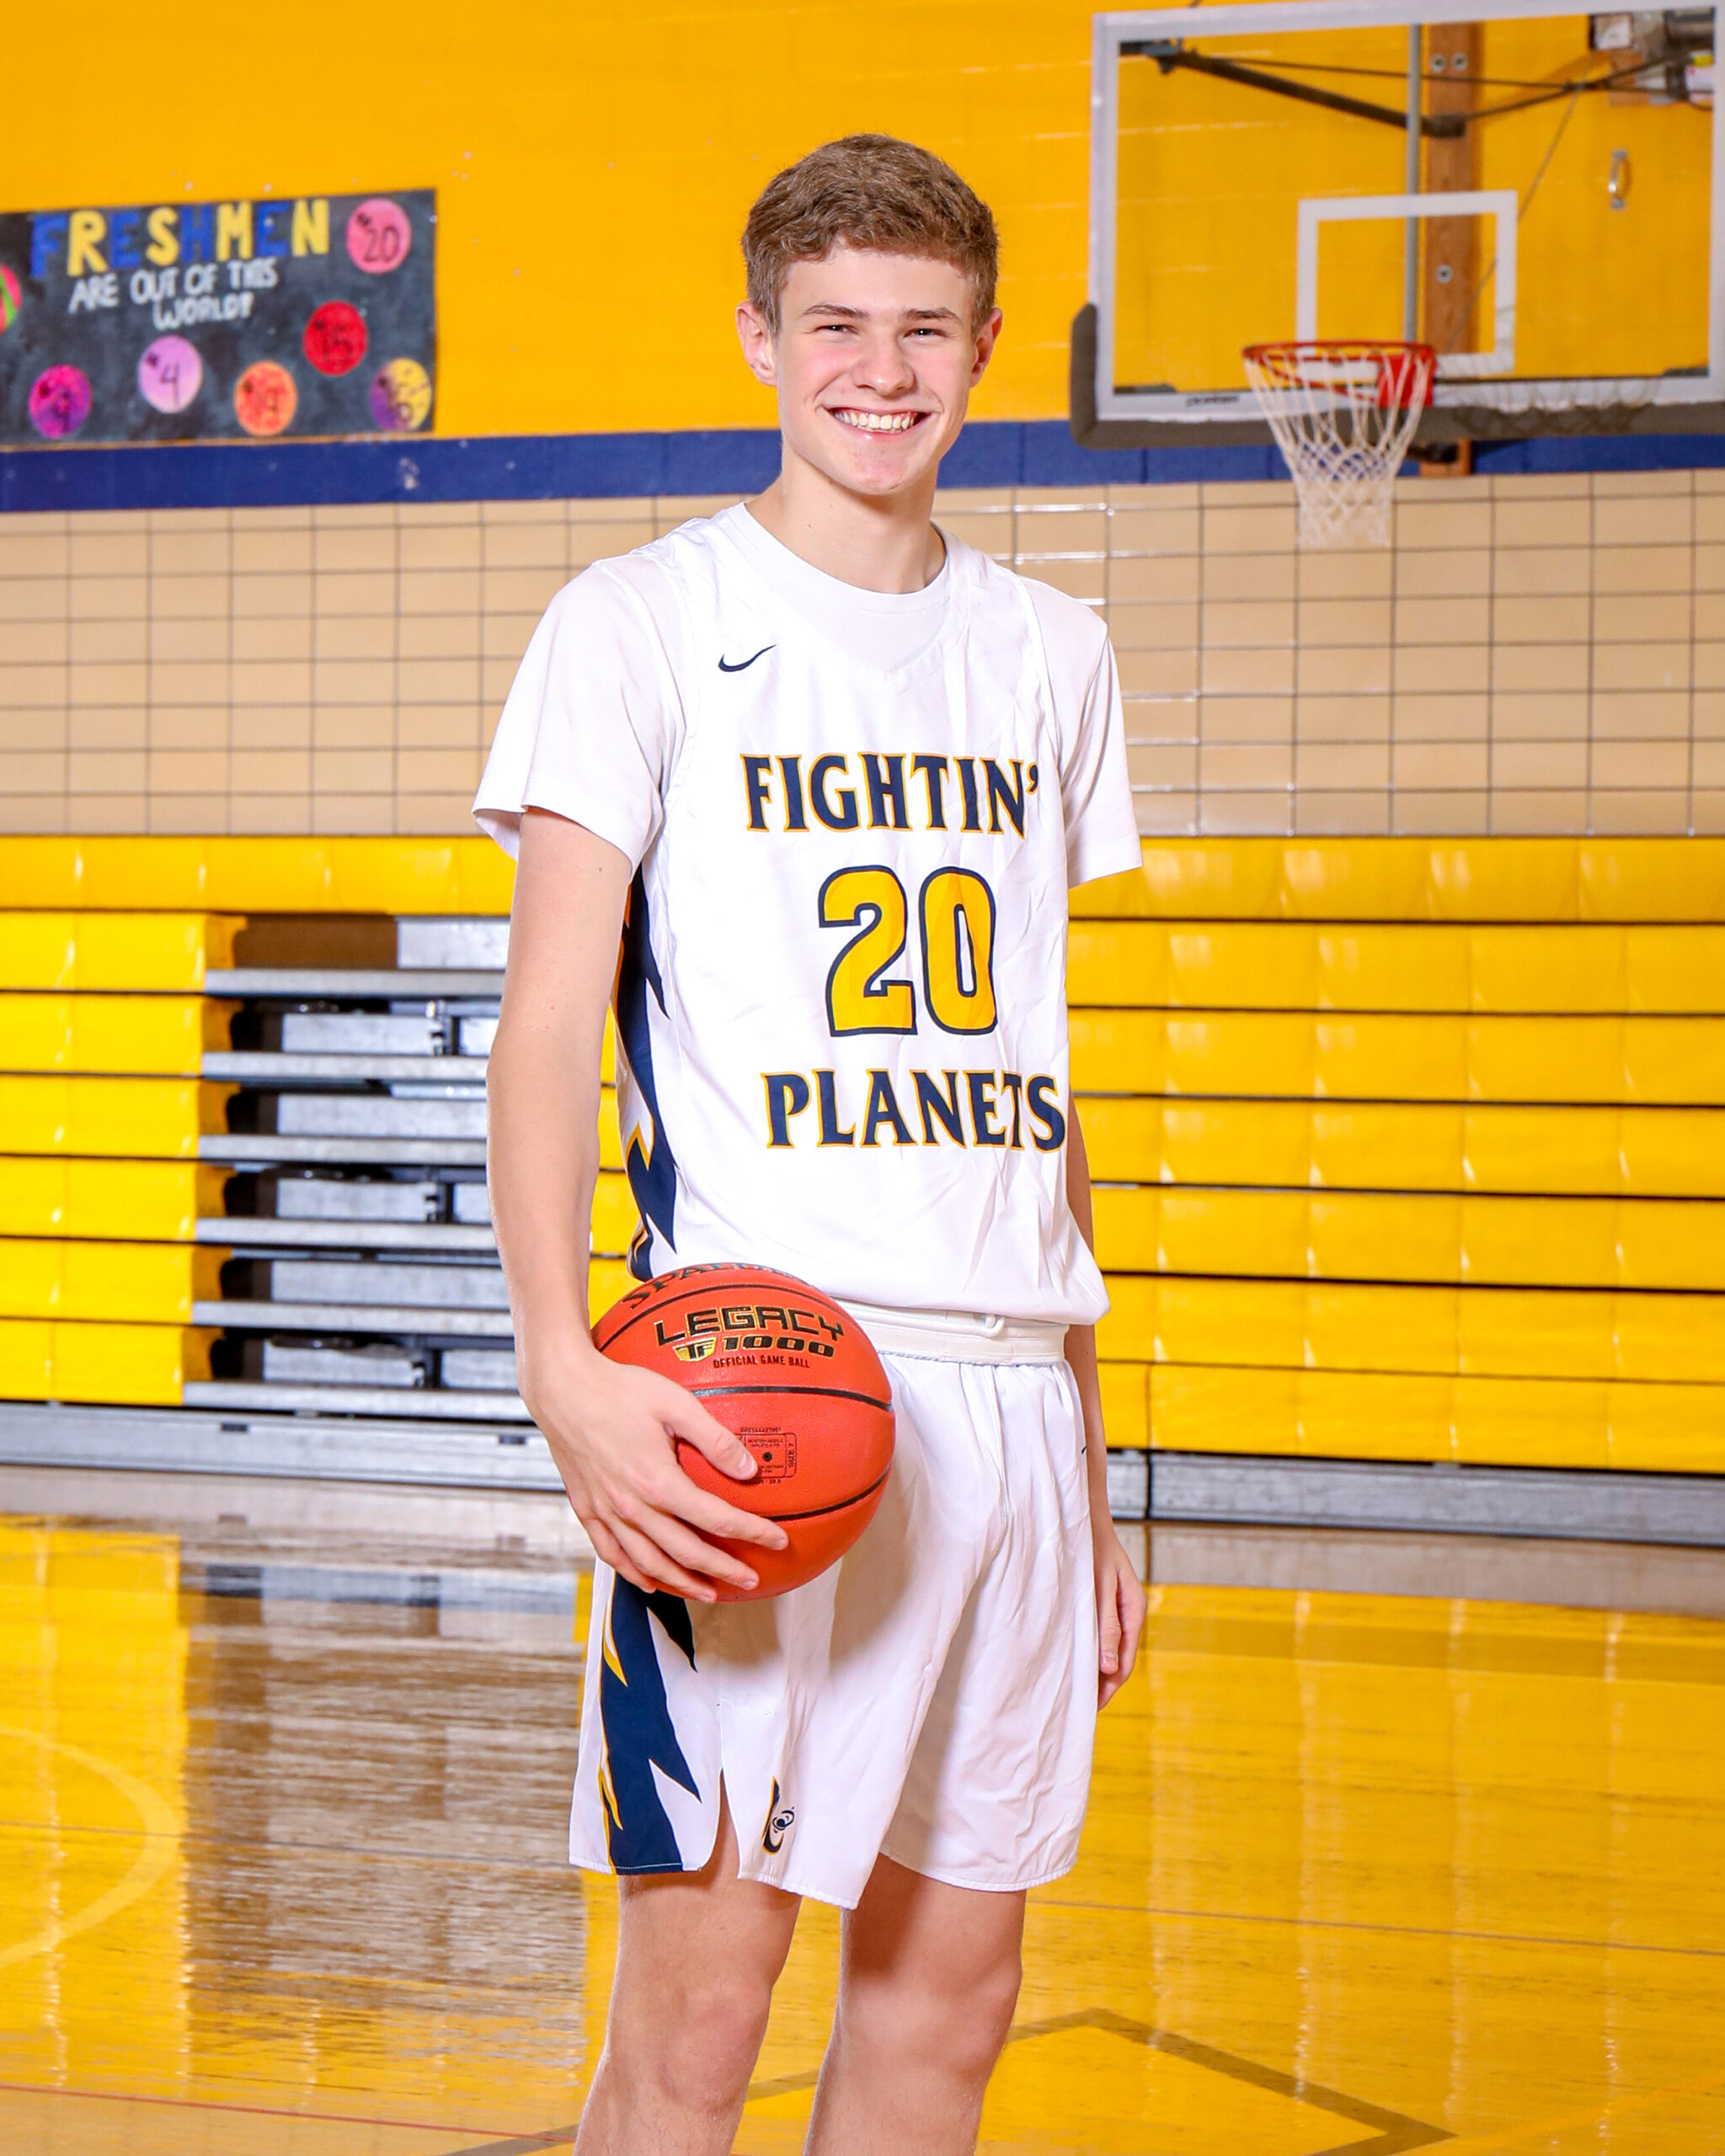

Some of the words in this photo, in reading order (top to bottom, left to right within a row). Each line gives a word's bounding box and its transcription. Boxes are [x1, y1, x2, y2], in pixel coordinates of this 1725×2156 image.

[30, 199, 329, 278] FRESHMEN
[68, 274, 120, 315] ARE
[129, 267, 179, 305] OUT
[184, 263, 218, 296] OF
[227, 257, 278, 289] THIS
[740, 752, 1038, 839] FIGHTIN'
[818, 865, 997, 1037] 20
[761, 1068, 1066, 1153] PLANETS
[654, 1305, 845, 1347] LEGACY
[723, 1335, 835, 1358] 1000
[713, 1355, 757, 1369] OFFICIAL
[760, 1354, 785, 1365] GAME
[788, 1357, 810, 1369] BALL
